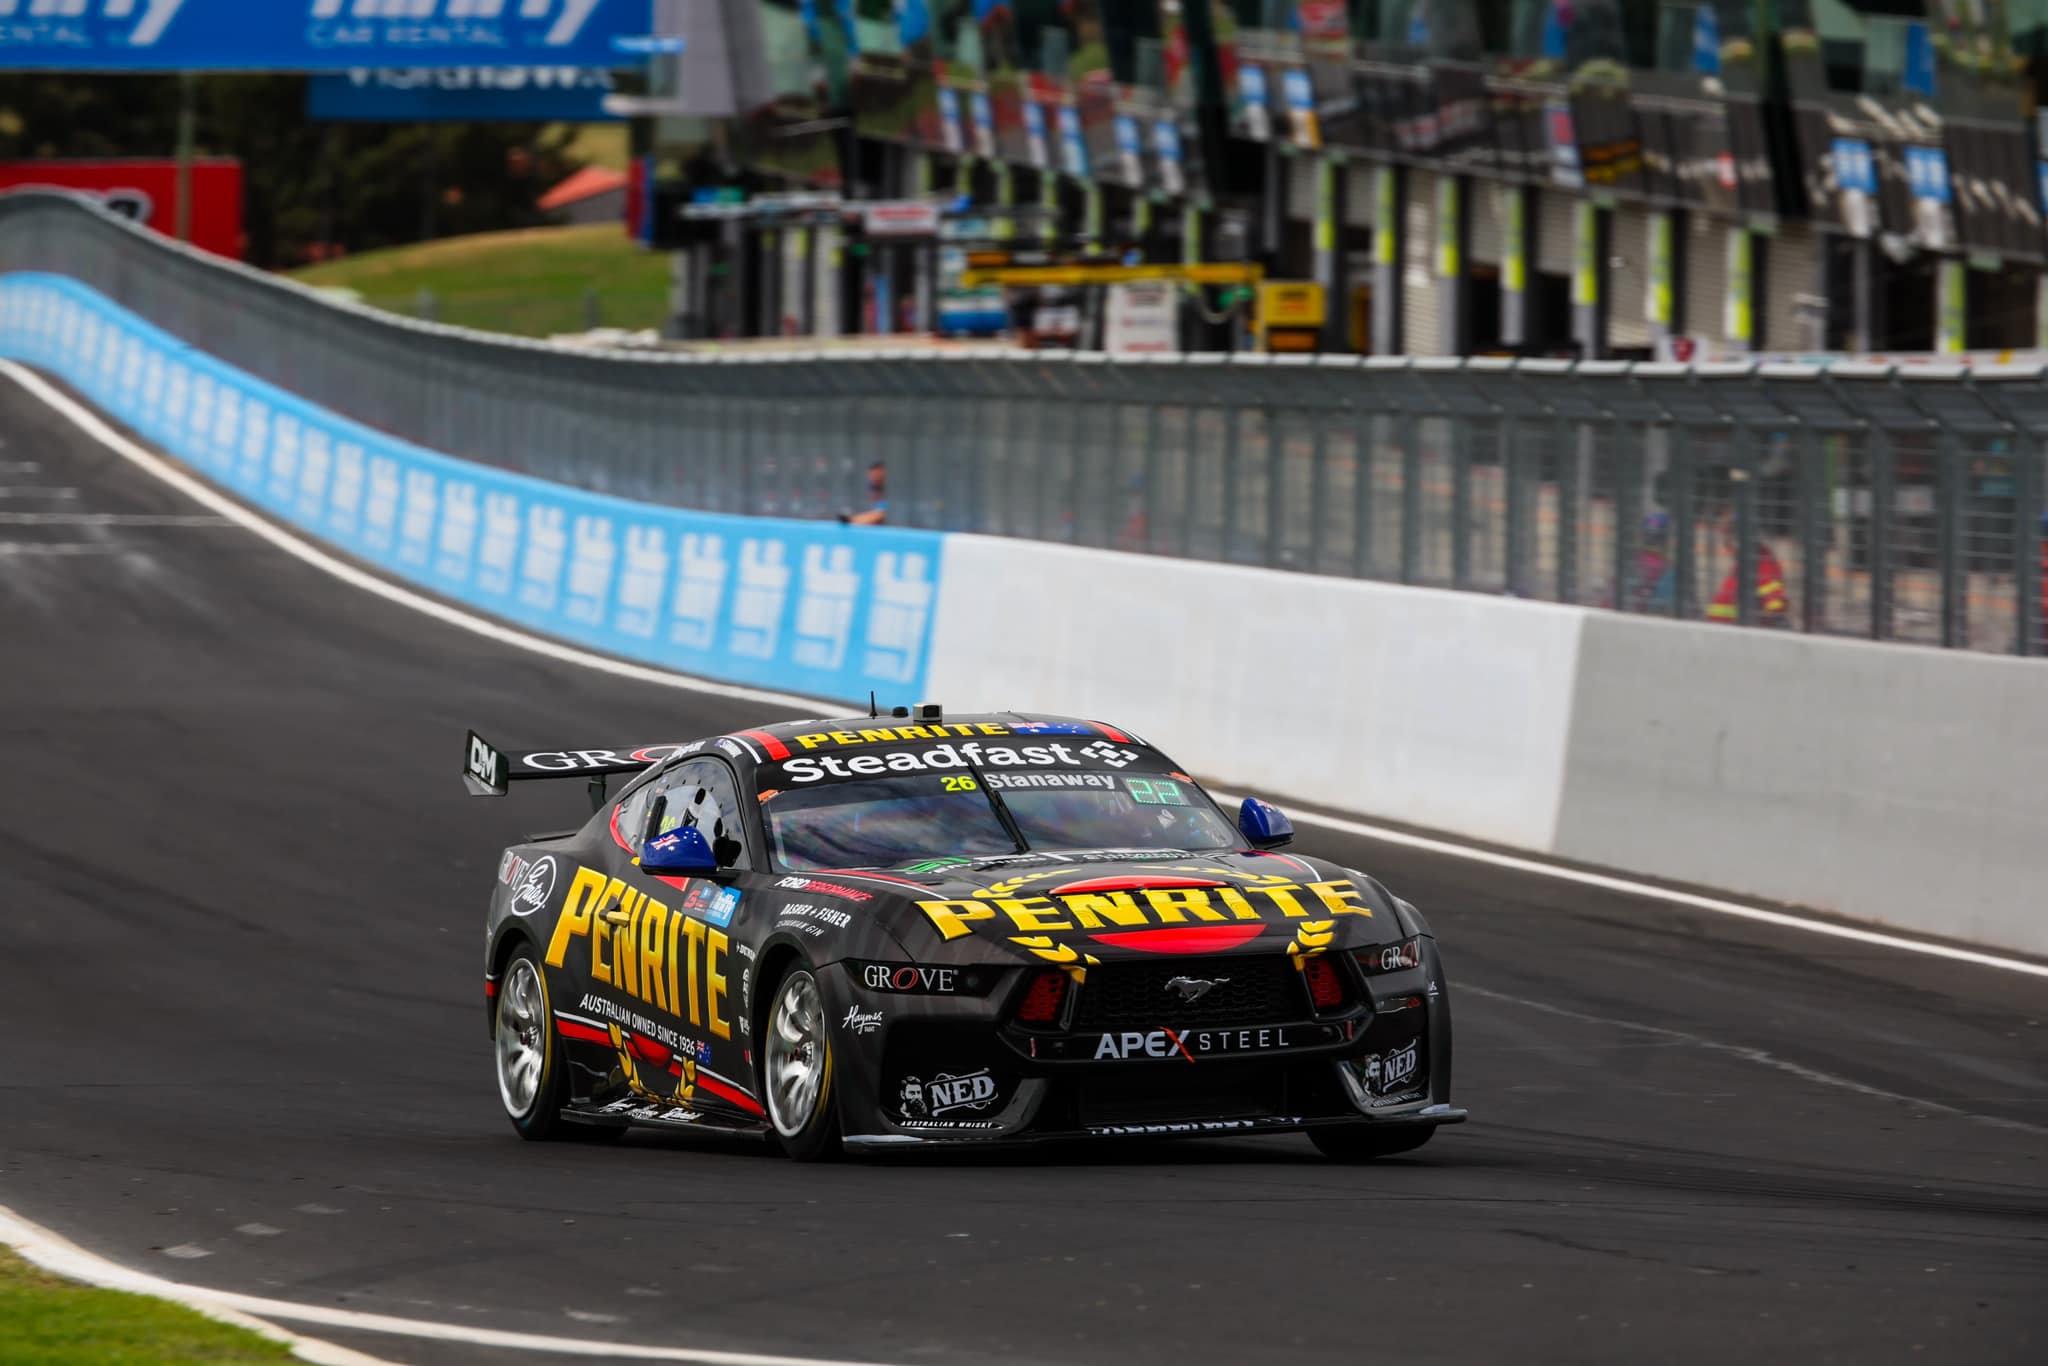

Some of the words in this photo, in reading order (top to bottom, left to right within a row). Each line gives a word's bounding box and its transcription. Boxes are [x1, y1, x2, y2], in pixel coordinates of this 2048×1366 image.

[795, 722, 1010, 749] PENRITE
[782, 742, 1081, 783] Steadfast
[941, 776, 977, 791] 26
[983, 774, 1116, 789] Stanaway
[814, 907, 852, 929] FISHER
[912, 879, 1373, 943] PENRITE
[545, 866, 731, 1041] PENRITE
[864, 965, 954, 991] GROVE
[580, 993, 632, 1026] AUSTRALIAN
[631, 1013, 657, 1038] OWNED
[657, 1025, 679, 1048] SINCE
[679, 1035, 696, 1056] 1926
[1094, 1026, 1196, 1064] APEX
[1200, 1028, 1289, 1050] STEEL
[1384, 1049, 1417, 1083] NED
[930, 1075, 995, 1108] NED
[900, 1120, 956, 1128] AUSTRALIAN
[958, 1121, 993, 1129] WHISKY
